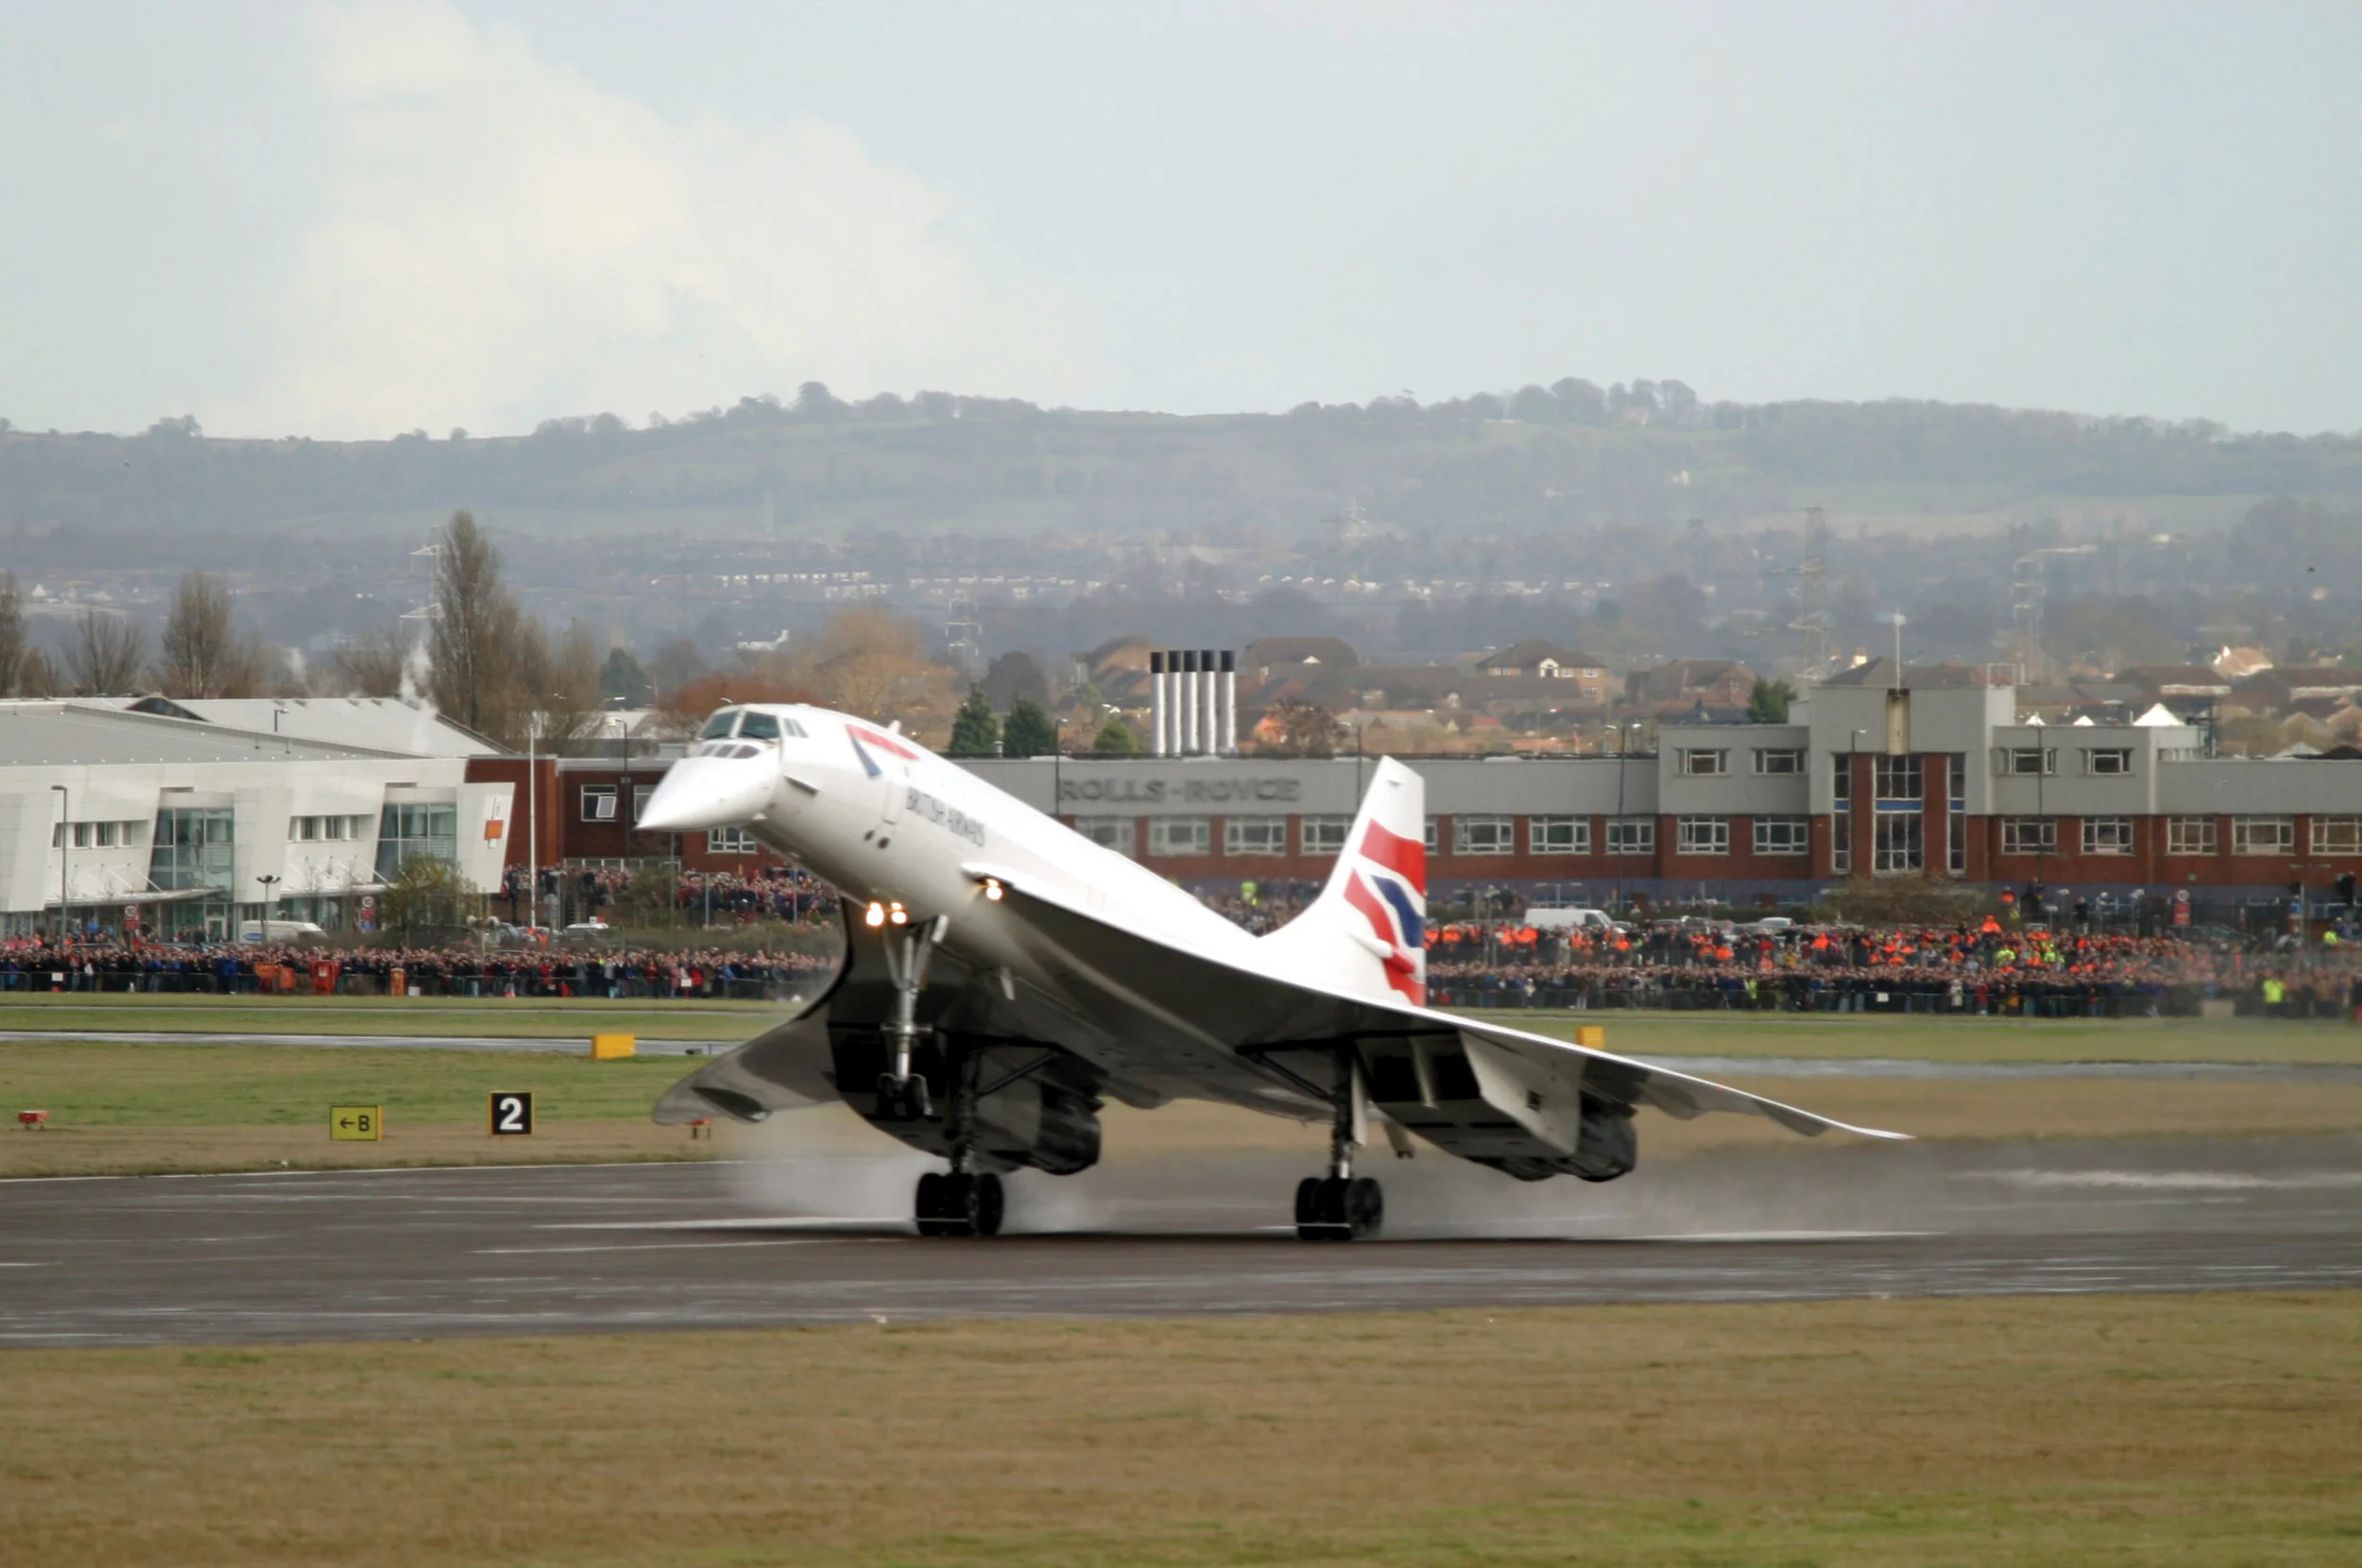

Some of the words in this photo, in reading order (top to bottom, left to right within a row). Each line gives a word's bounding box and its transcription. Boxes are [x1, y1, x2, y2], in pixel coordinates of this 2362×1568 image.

[1059, 777, 1301, 802] ROLLS-ROYCE
[358, 1115, 370, 1132] B
[499, 1098, 524, 1131] 2
